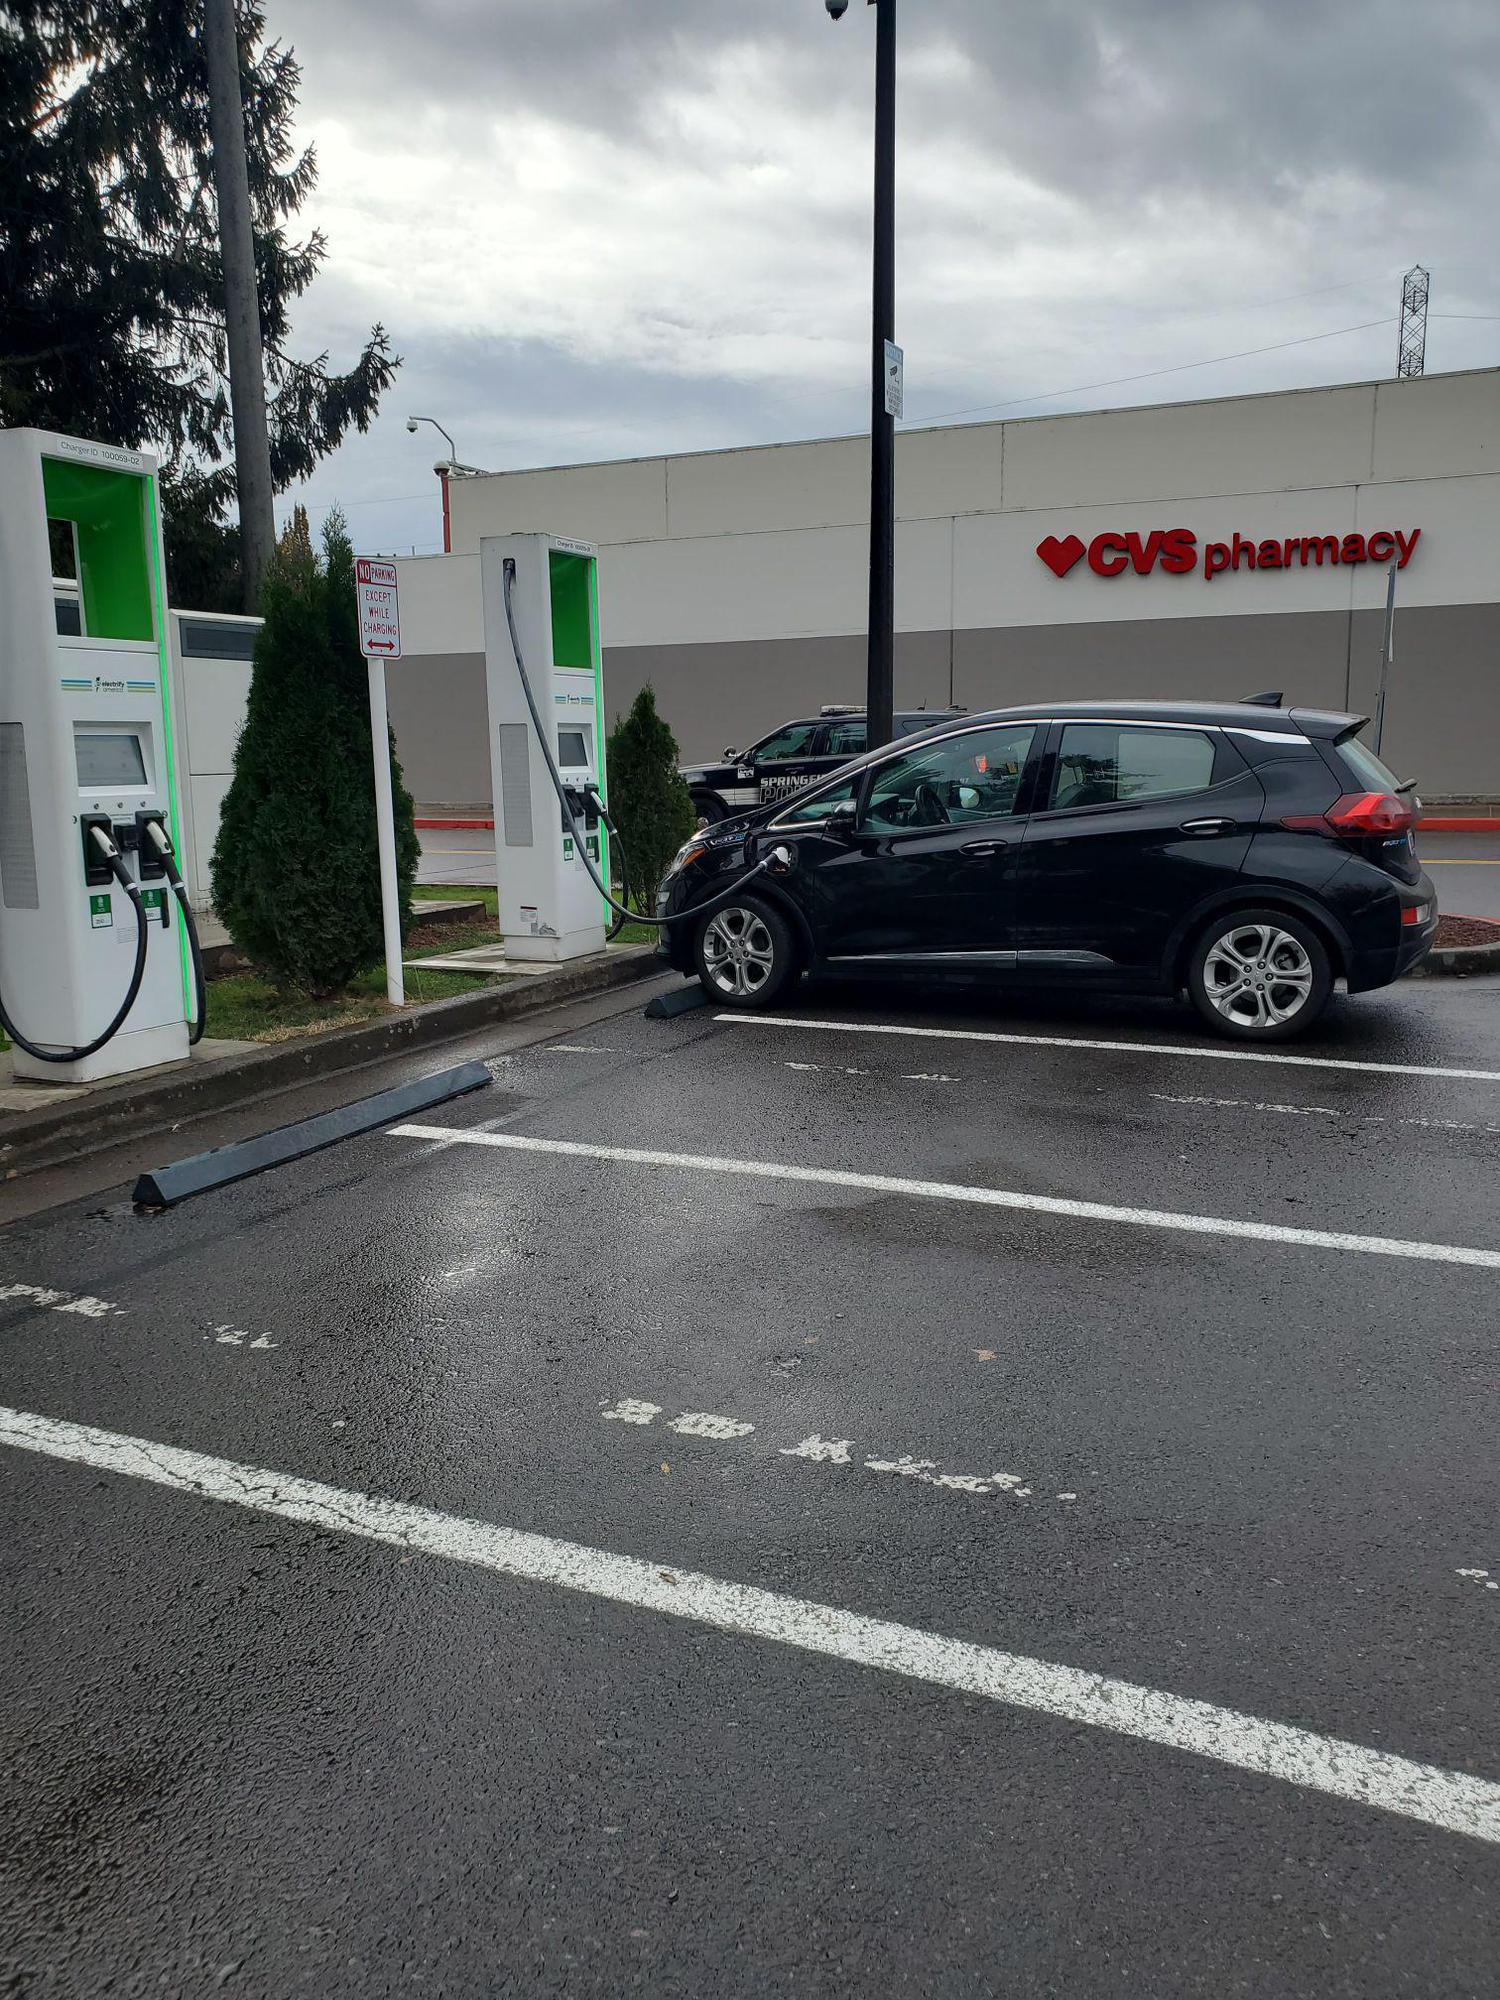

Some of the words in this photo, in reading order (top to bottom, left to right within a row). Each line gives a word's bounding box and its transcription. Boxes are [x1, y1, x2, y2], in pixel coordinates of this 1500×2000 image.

[60, 441, 90, 455] Charger
[1087, 528, 1198, 577] CVS
[1204, 528, 1421, 580] pharmacy
[359, 563, 370, 581] NO
[371, 567, 395, 581] PARKING
[365, 589, 392, 603] EXCEPT
[368, 607, 390, 619] WHILE
[363, 621, 397, 636] CHARGING
